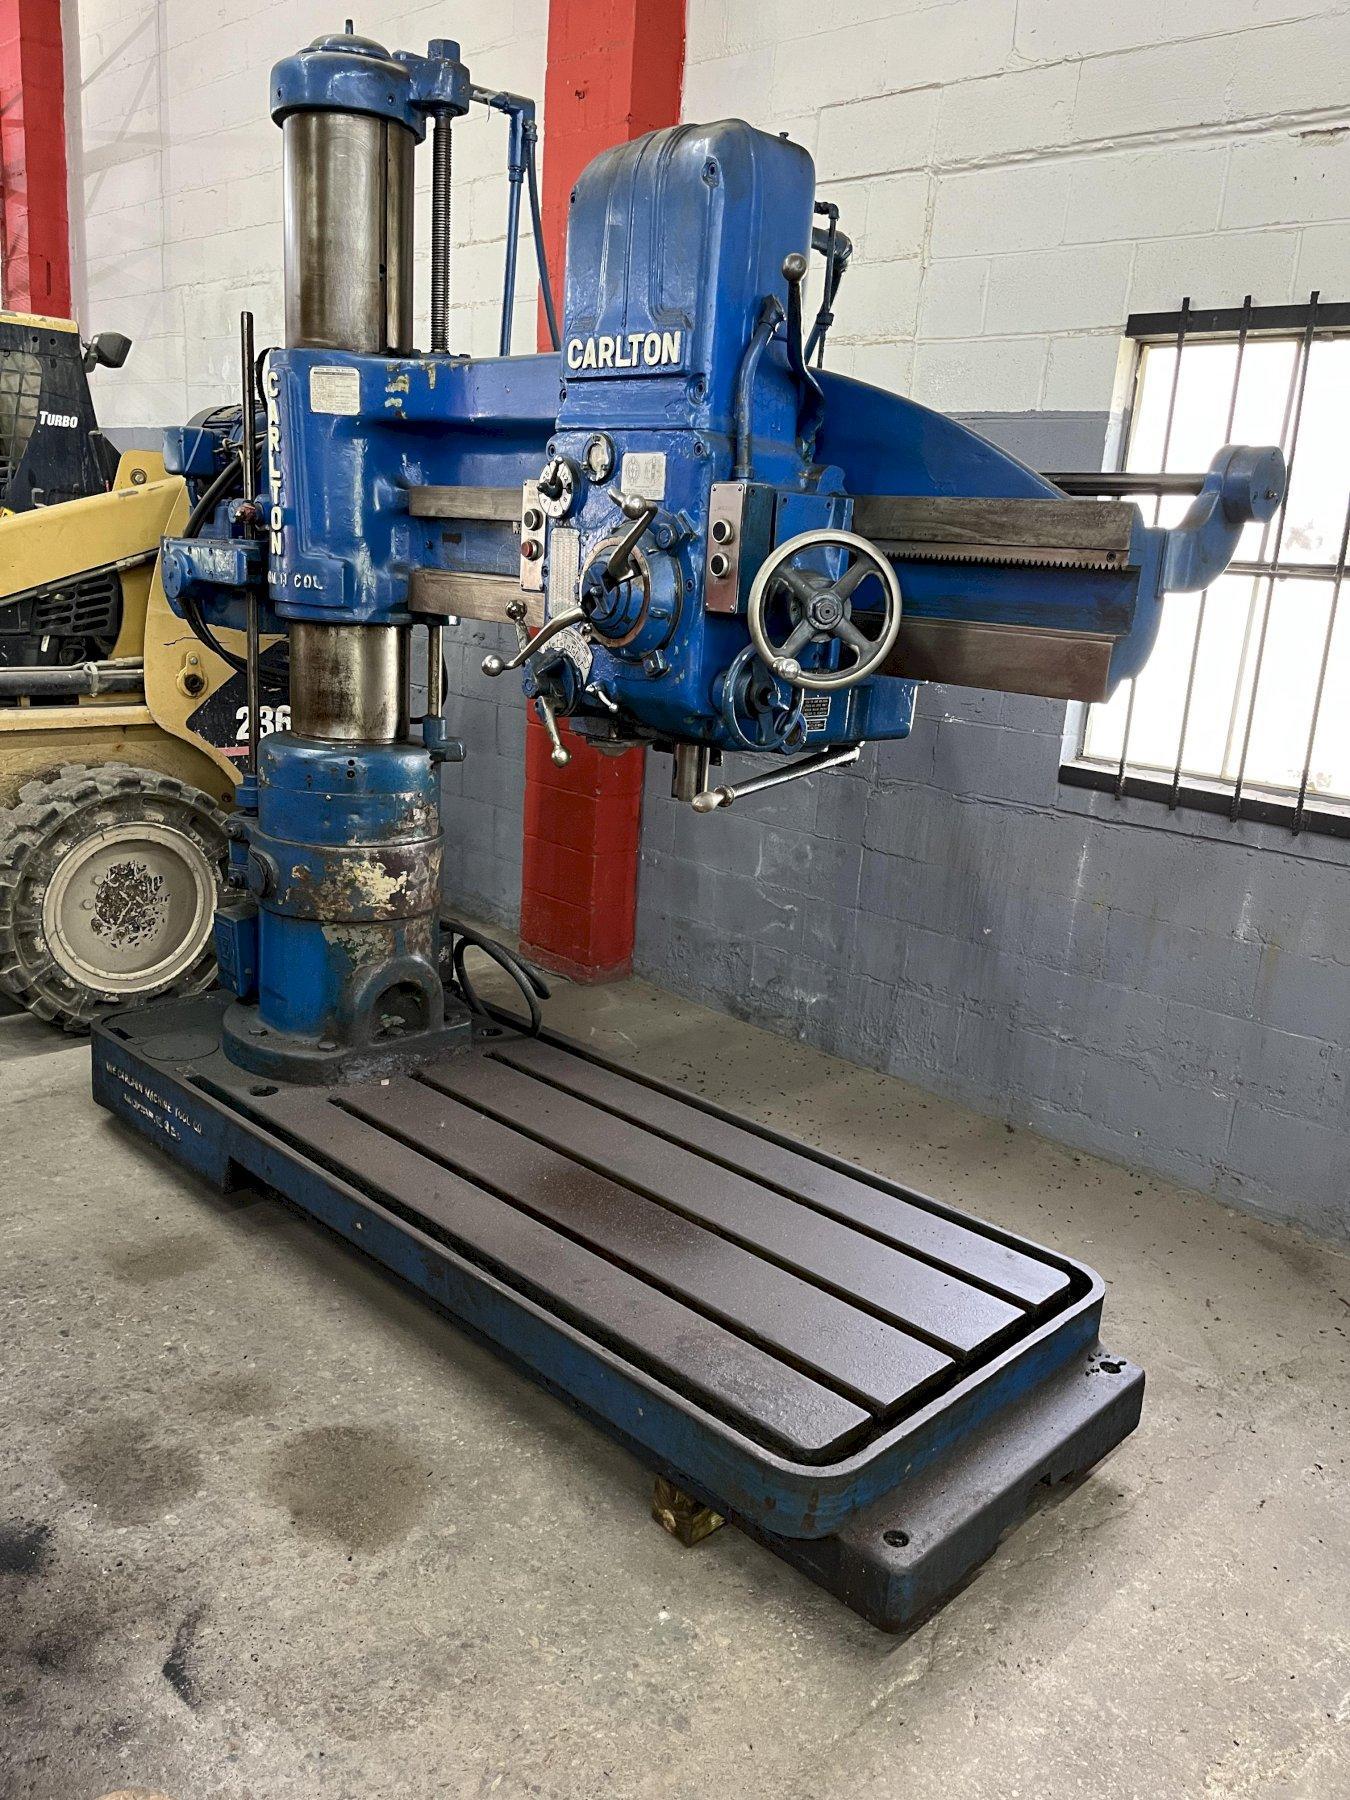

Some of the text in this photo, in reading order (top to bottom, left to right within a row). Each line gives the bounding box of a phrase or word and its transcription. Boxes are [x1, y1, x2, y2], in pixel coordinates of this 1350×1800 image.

[567, 331, 681, 370] CARLTON
[39, 410, 79, 429] TURBO
[267, 371, 282, 555] CARLTON
[235, 704, 292, 741] 236
